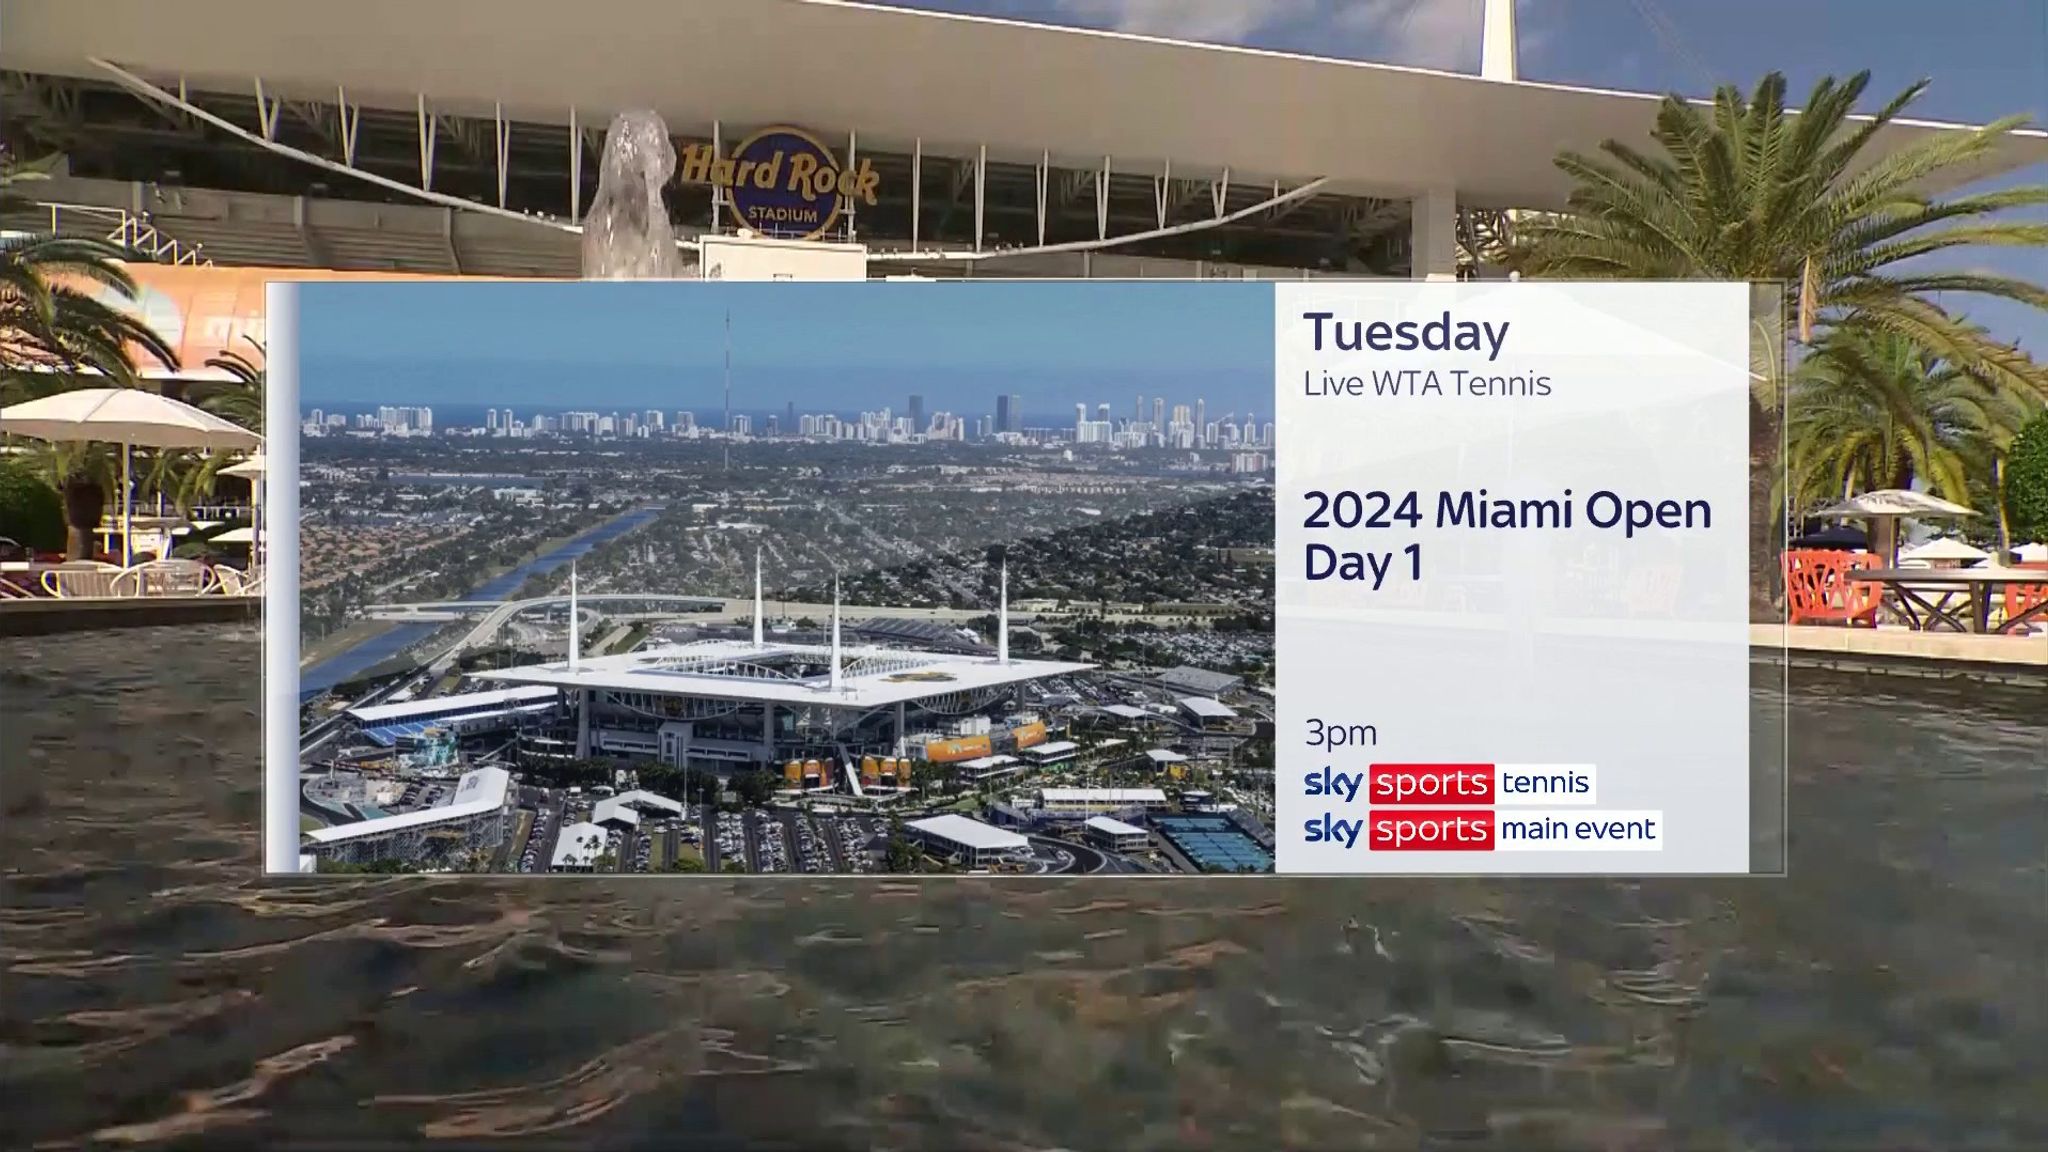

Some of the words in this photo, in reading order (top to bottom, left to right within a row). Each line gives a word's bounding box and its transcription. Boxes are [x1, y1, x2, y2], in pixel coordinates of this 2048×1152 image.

[681, 145, 784, 189] Hard
[786, 151, 880, 206] Rock
[748, 205, 818, 224] STADIUM
